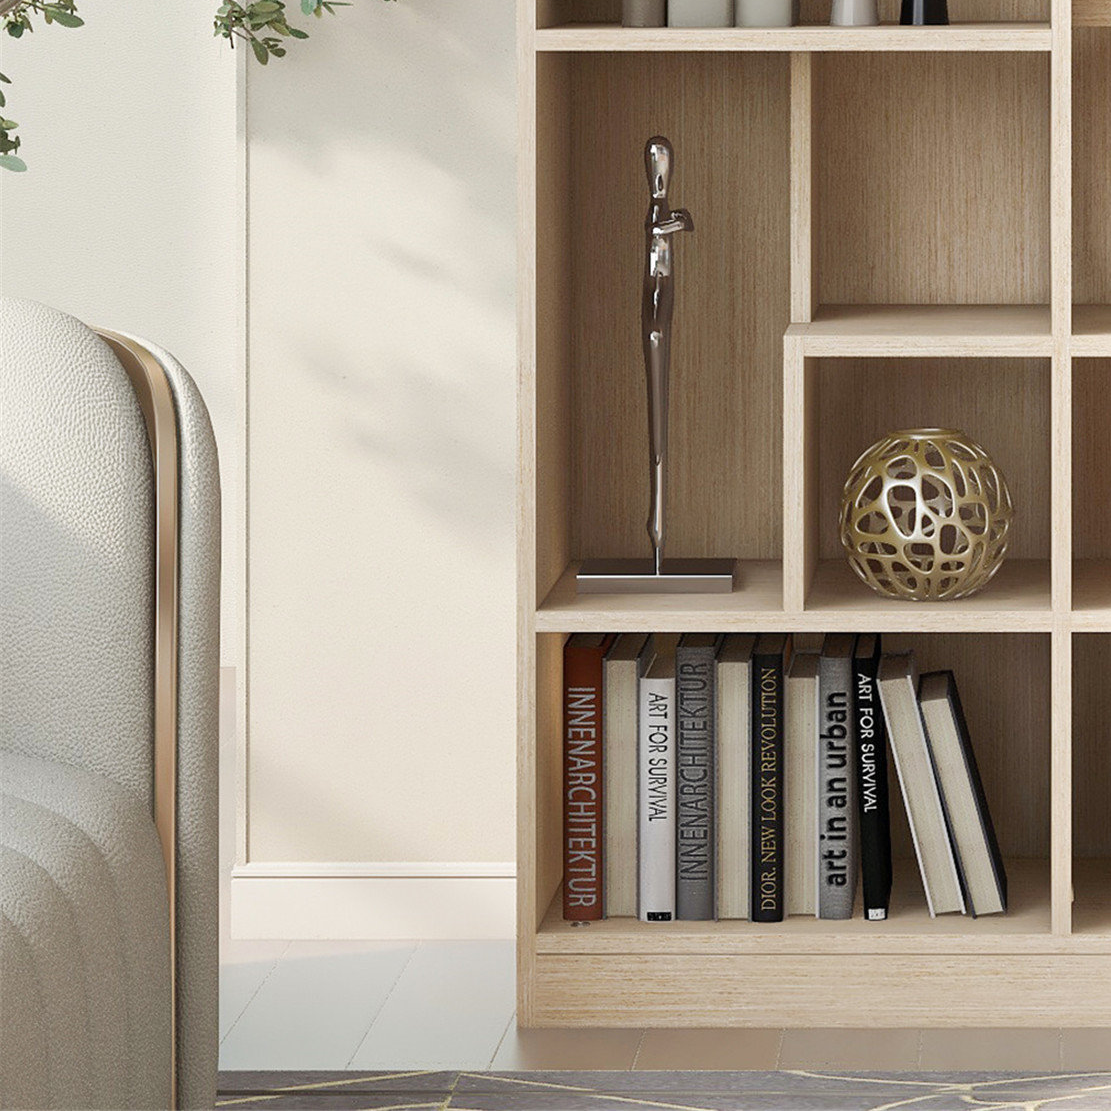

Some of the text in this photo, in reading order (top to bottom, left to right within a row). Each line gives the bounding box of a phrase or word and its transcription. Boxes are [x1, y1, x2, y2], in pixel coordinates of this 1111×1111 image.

[568, 687, 597, 907] INNENARCHITEKTUR
[647, 692, 669, 822] ART FOR SURVIVAL
[679, 662, 708, 882] INNENARCHITEKTUR
[760, 668, 777, 911] DIOR. NEW LOOK REVOLUTION
[820, 691, 848, 887] art in an urban
[857, 673, 878, 813] ART FOR SURVIVAL
